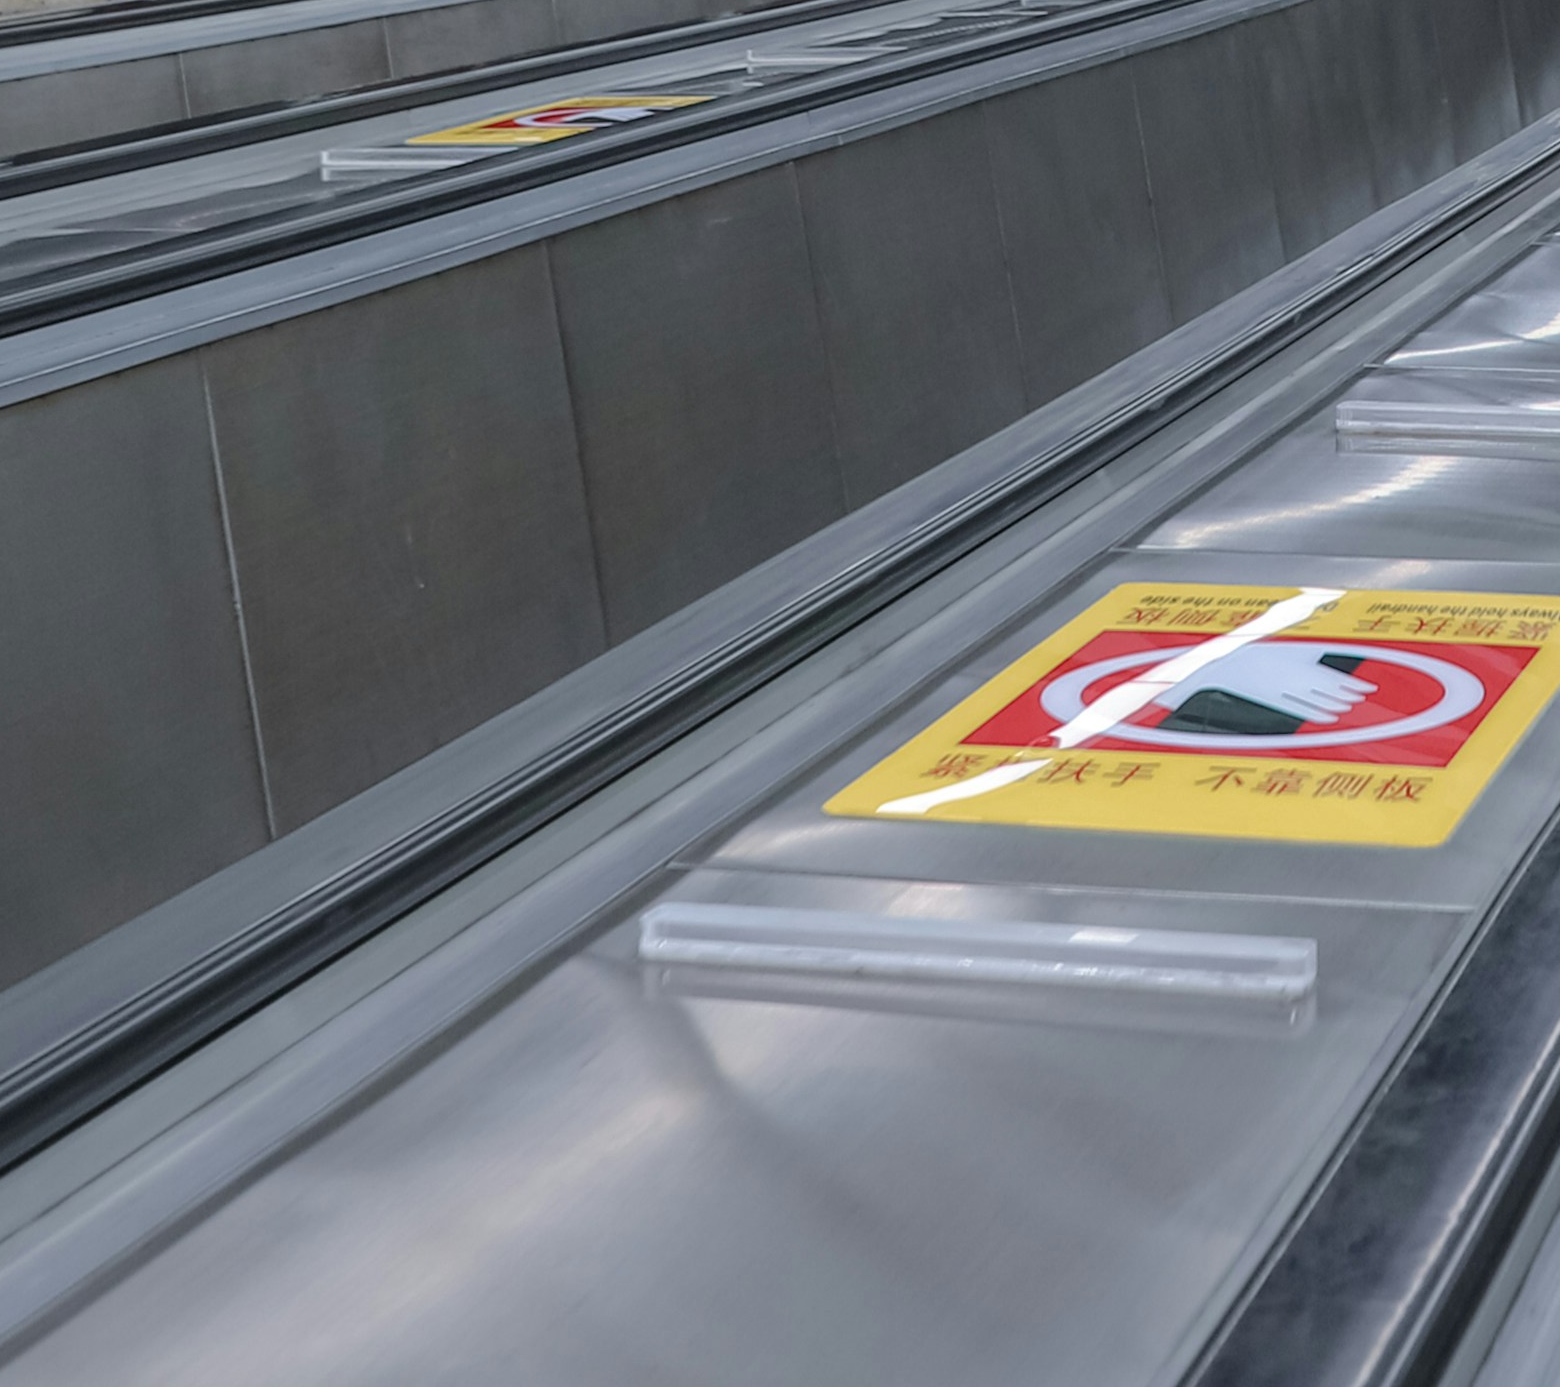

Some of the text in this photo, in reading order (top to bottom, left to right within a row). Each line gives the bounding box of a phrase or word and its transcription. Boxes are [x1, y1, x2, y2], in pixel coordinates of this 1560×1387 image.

[1140, 594, 1177, 606] side
[1182, 595, 1212, 606] the
[1366, 602, 1438, 617] handrail
[1440, 604, 1466, 618] the
[1468, 606, 1507, 620] hold
[1353, 615, 1557, 641] 紧握扶手
[920, 753, 1433, 802] 紧扶手 不靠侧板
